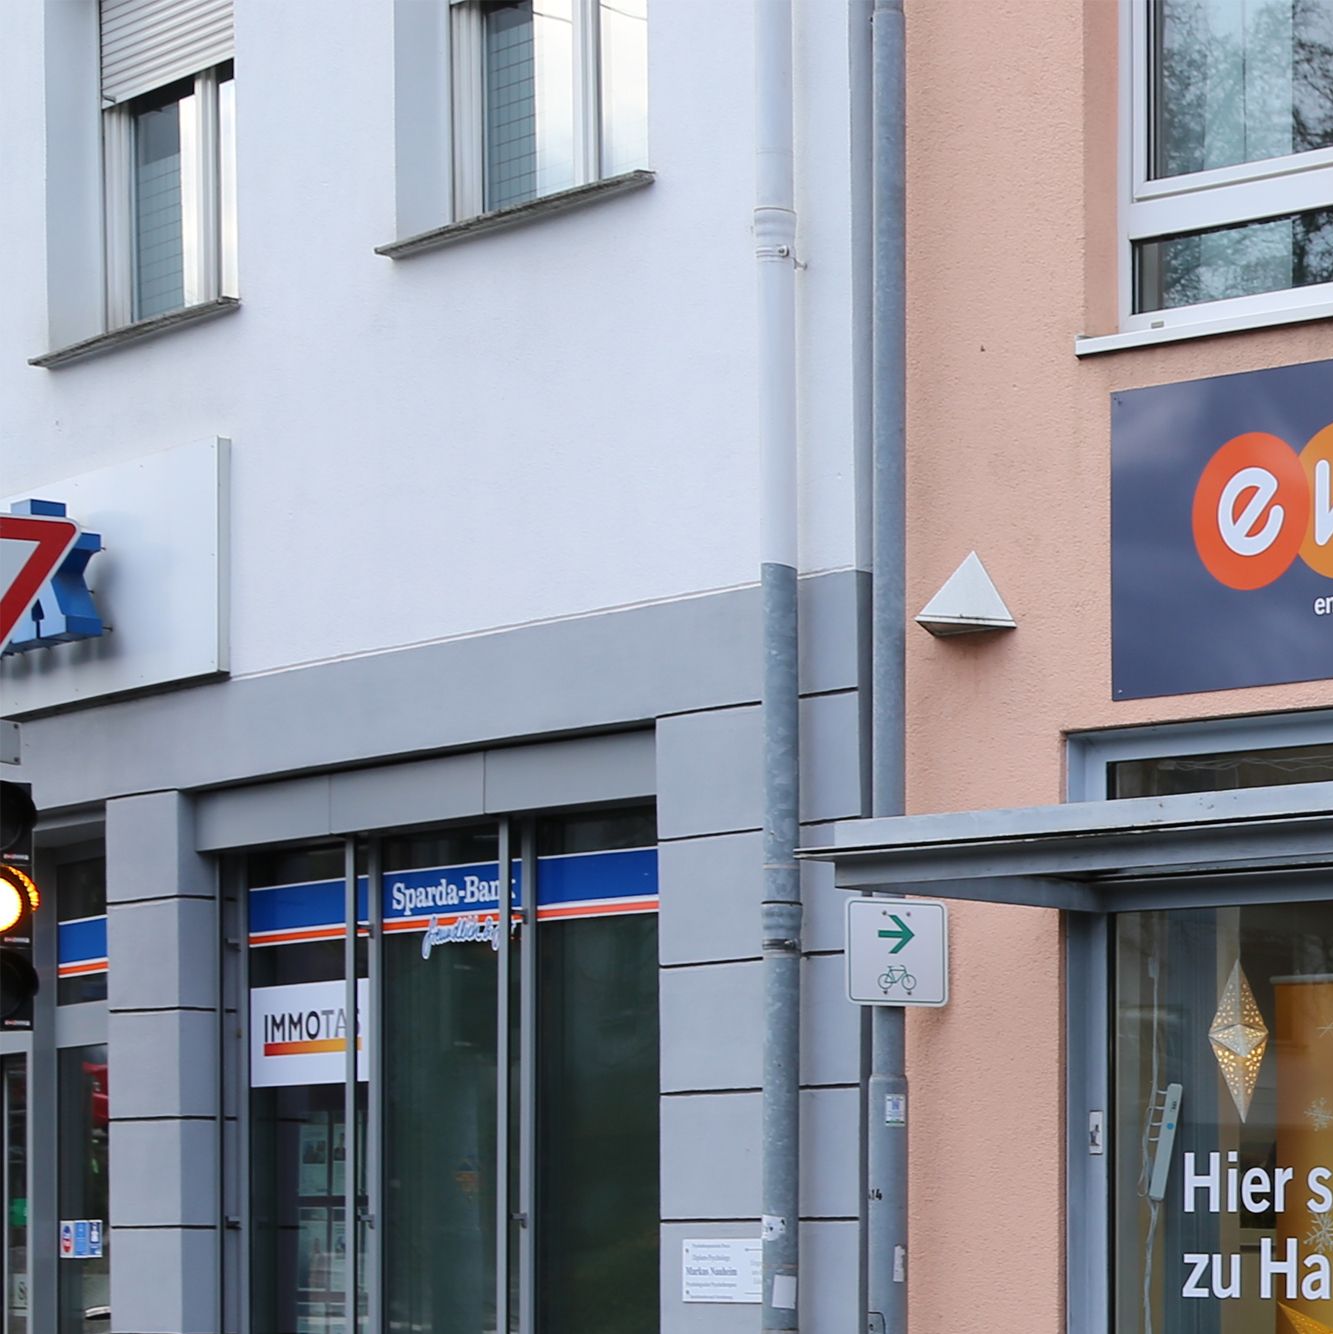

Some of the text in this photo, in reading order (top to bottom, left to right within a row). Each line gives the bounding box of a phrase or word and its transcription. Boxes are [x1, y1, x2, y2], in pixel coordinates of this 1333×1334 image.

[264, 1008, 361, 1042] IMMOTA
[1184, 1151, 1293, 1213] Hier
[1182, 1253, 1240, 1298] zu
